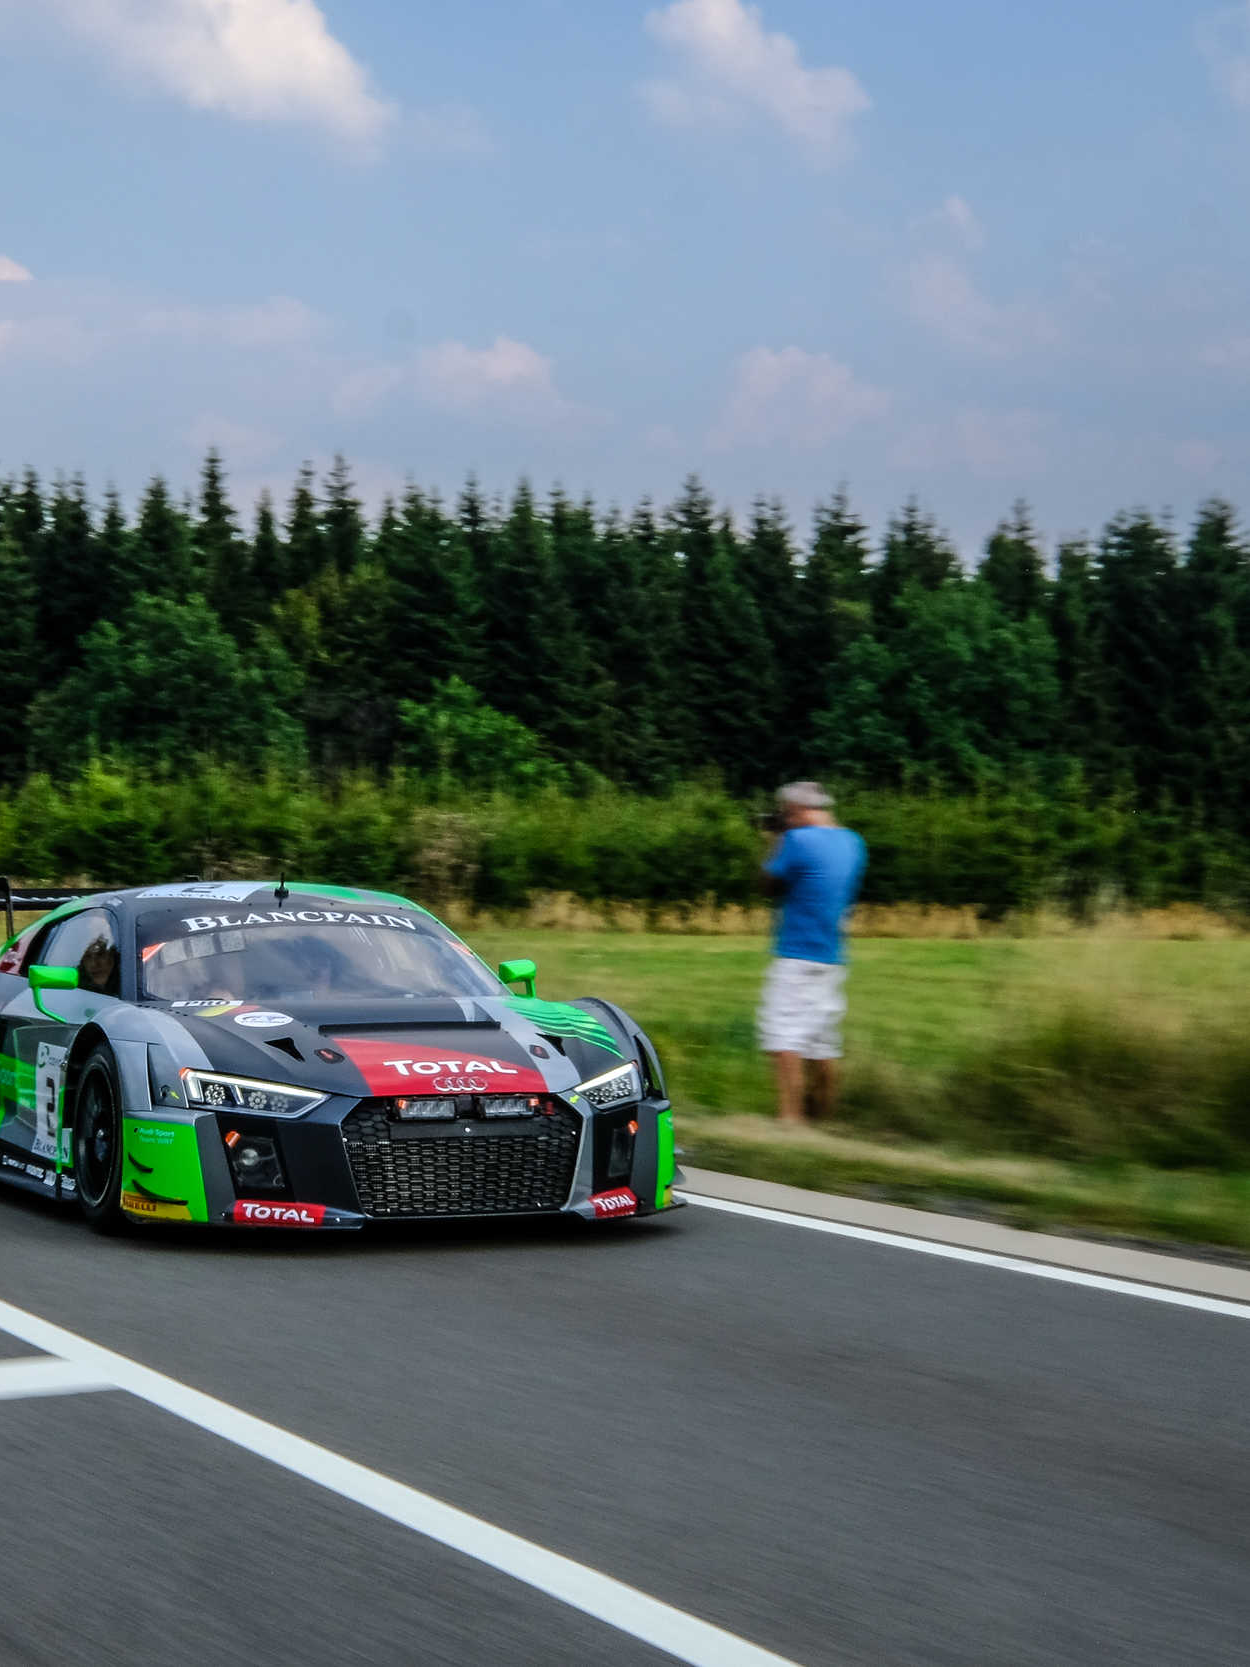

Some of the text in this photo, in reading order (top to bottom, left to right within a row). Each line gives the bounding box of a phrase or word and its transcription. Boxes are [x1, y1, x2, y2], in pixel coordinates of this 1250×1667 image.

[181, 910, 417, 932] BLANCPAIN
[382, 1059, 519, 1076] TOTAL
[593, 1194, 636, 1212] TOTAL
[242, 1203, 315, 1223] TOTAL
